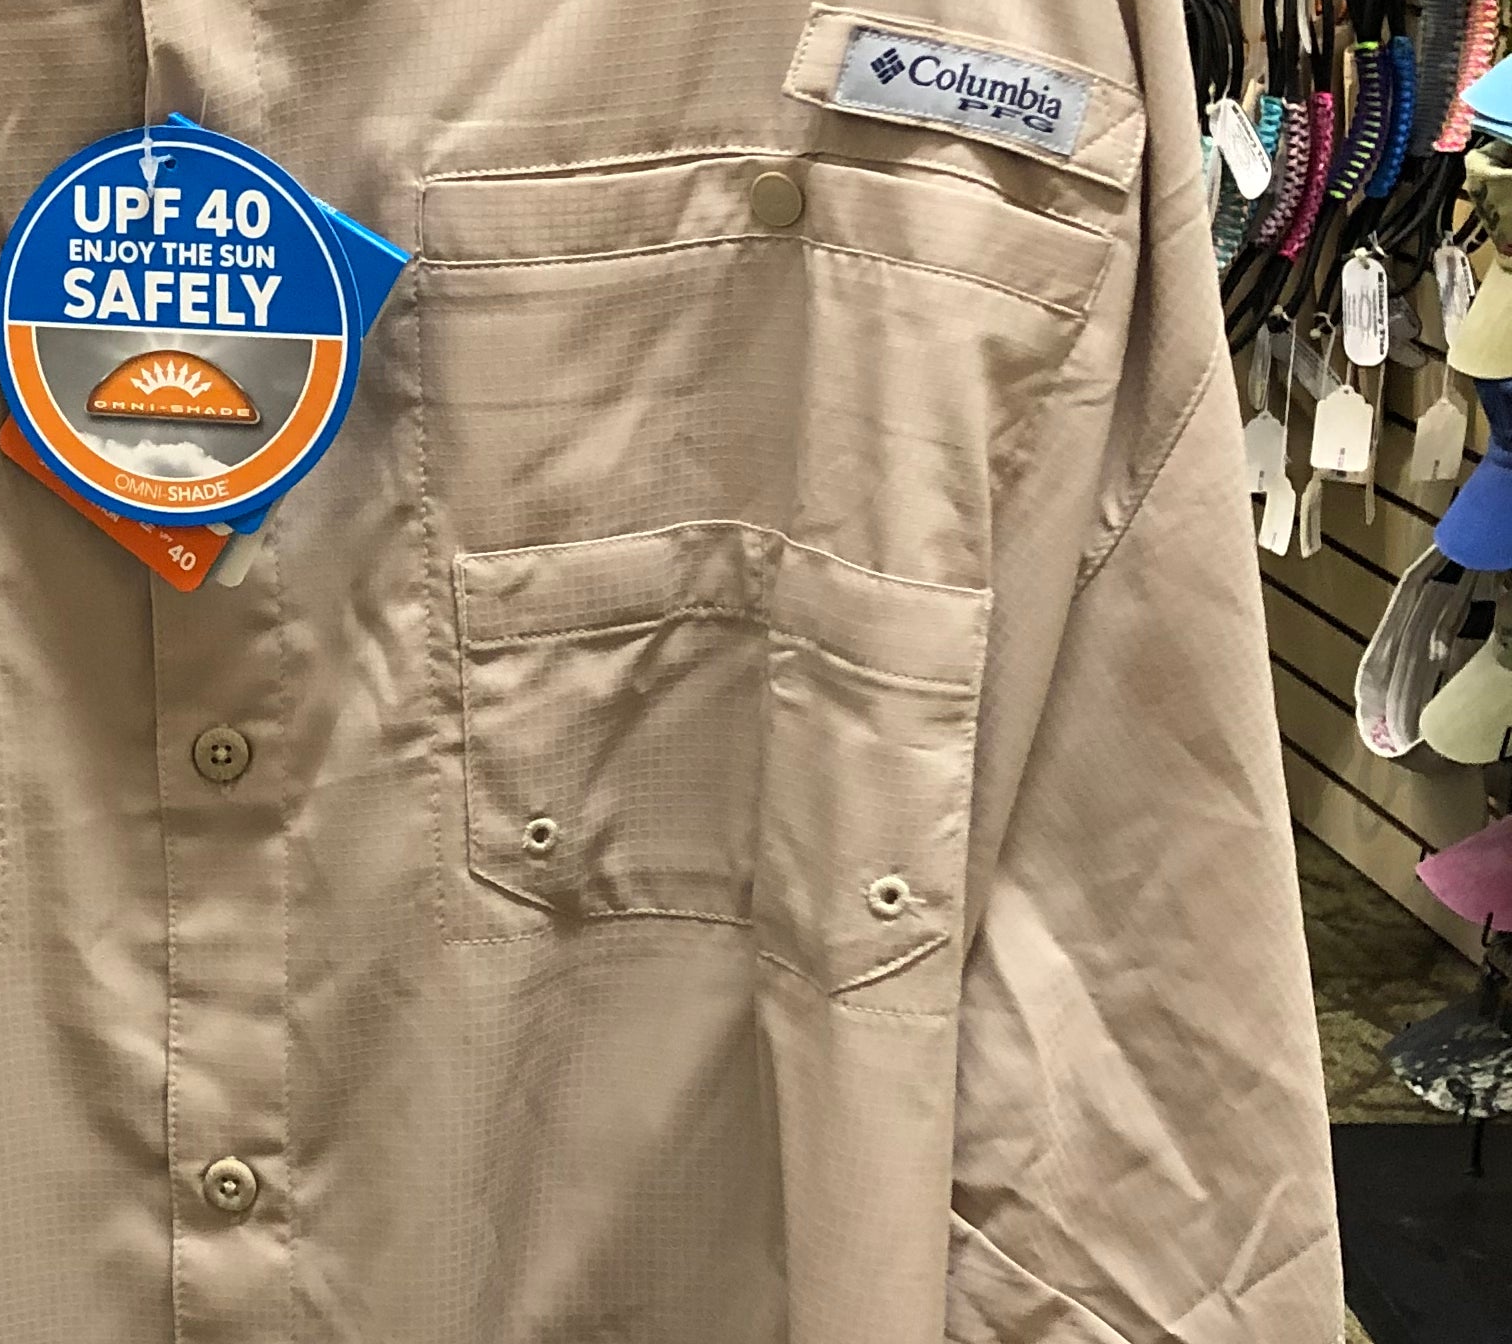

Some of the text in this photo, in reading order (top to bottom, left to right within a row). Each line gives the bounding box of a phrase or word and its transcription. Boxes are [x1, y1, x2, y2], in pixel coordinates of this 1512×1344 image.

[908, 54, 1063, 120] Columbia
[958, 98, 1054, 134] PFG
[74, 185, 271, 239] UPF 40
[69, 239, 275, 269] ENJOY THE SUN
[63, 267, 282, 327] SAFELY
[94, 400, 250, 416] OMNI-SHADE
[115, 473, 230, 502] OMNI-SHADE
[167, 544, 197, 571] 40
